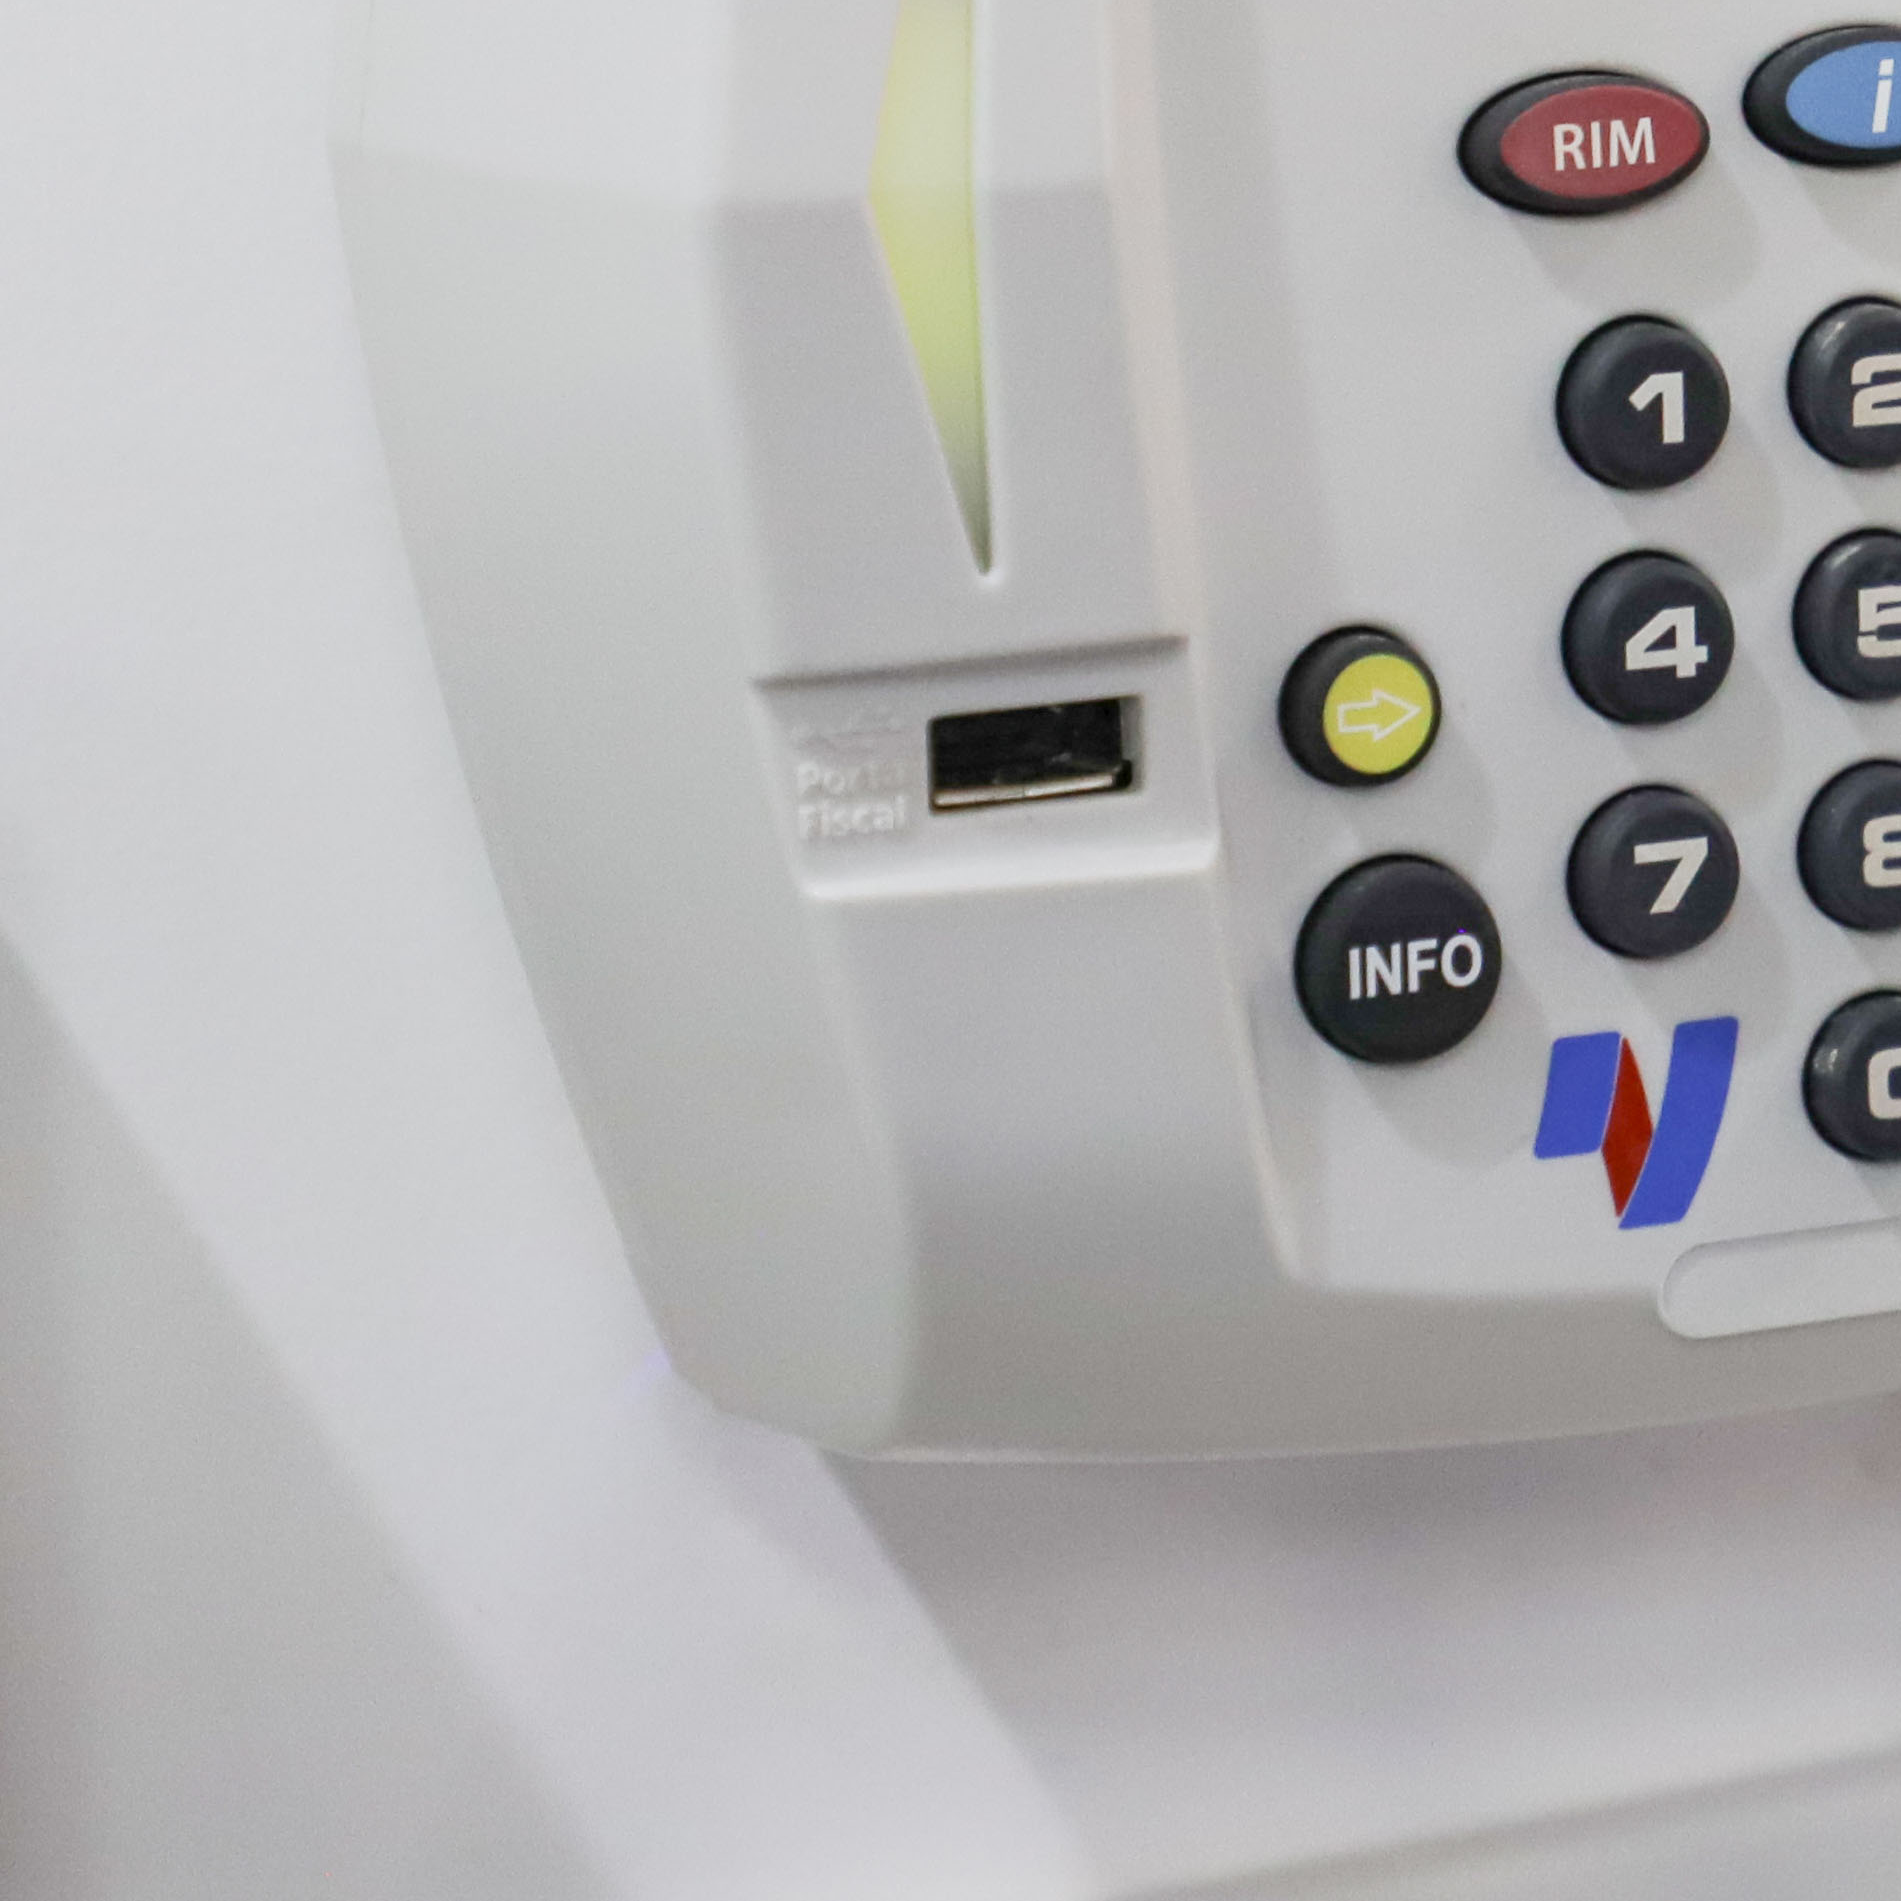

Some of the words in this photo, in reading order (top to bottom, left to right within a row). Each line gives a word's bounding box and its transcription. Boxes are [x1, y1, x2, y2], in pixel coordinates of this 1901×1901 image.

[1552, 115, 1657, 173] RIM
[1628, 371, 1685, 444] 1
[1625, 605, 1709, 679] 4
[1633, 836, 1709, 914] 7
[1347, 932, 1484, 1001] INFO
